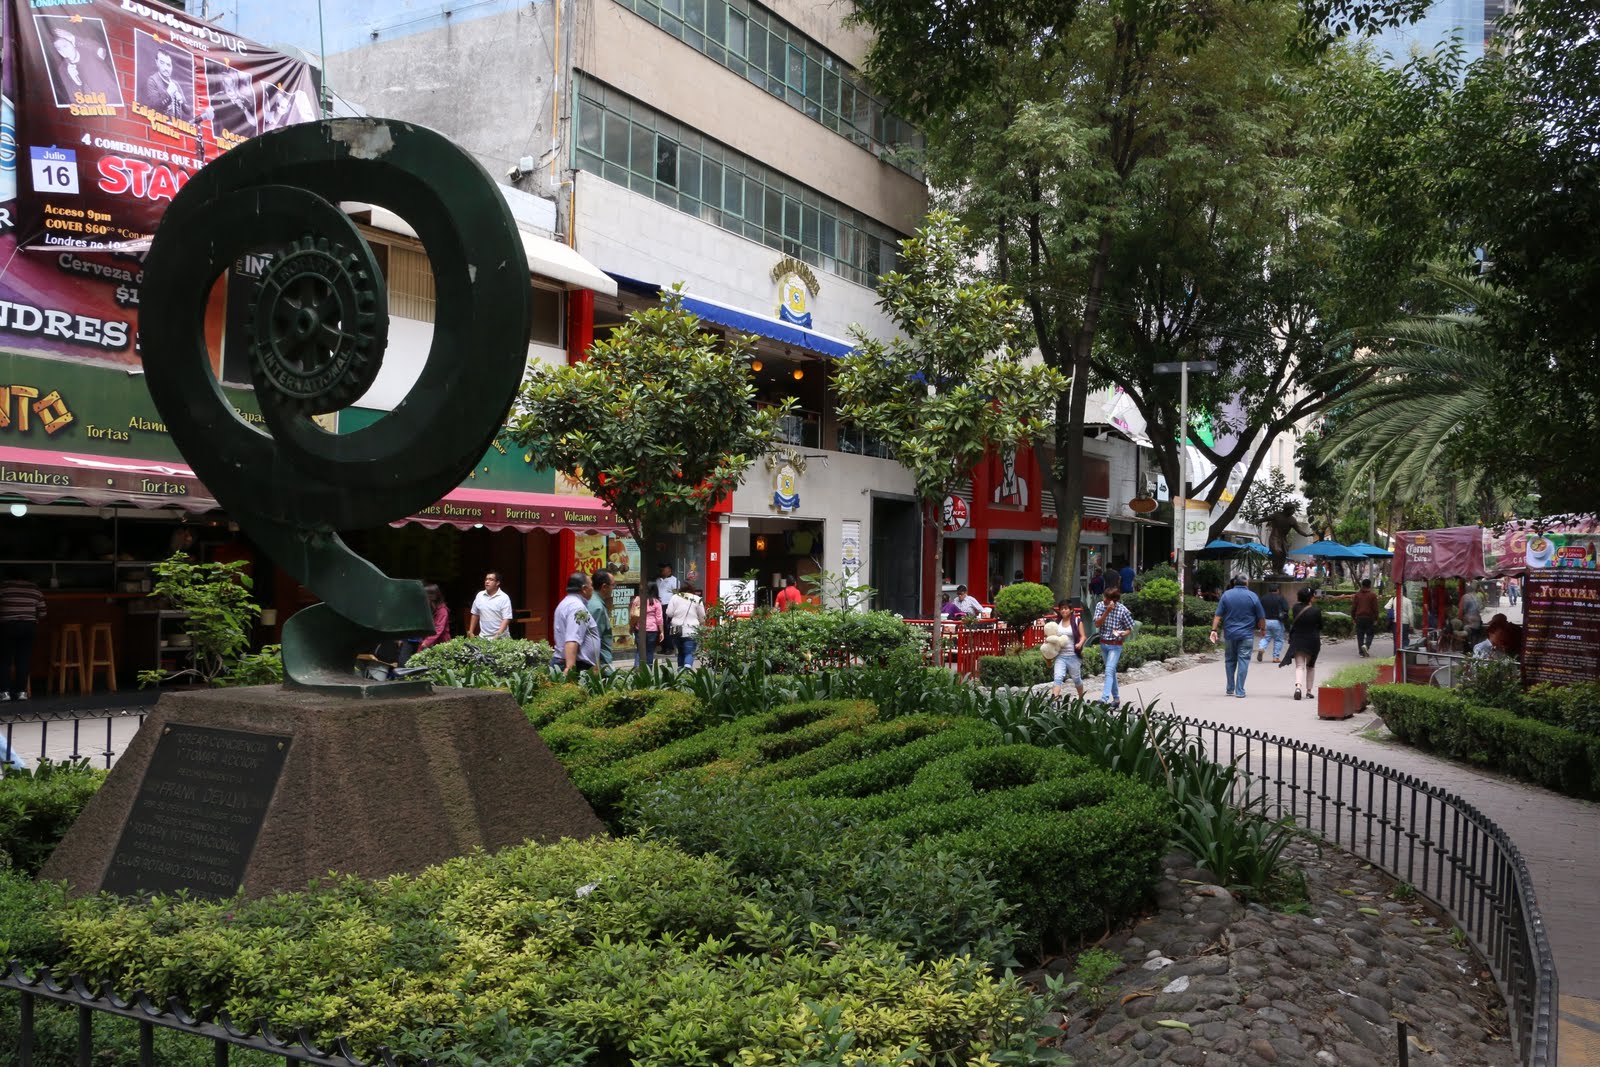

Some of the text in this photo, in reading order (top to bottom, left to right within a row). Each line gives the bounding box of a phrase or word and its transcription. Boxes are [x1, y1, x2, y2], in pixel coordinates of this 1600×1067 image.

[132, 101, 169, 124] Edgar
[43, 150, 66, 161] Julio
[81, 134, 91, 145] 4
[95, 137, 169, 161] COMEDIANTES
[172, 154, 190, 169] QUE
[42, 165, 71, 187] 16
[45, 204, 112, 222] Acceso 9pm
[45, 219, 83, 232] COVER
[45, 233, 87, 248] Londres
[59, 253, 132, 282] Cerveza
[86, 424, 129, 441] Tortas
[141, 478, 186, 494] Tortas
[443, 503, 482, 517] Charros
[506, 508, 540, 520] Burritos
[564, 511, 597, 523] Volcanes
[1186, 520, 1207, 535] go
[1406, 543, 1433, 556] Corona
